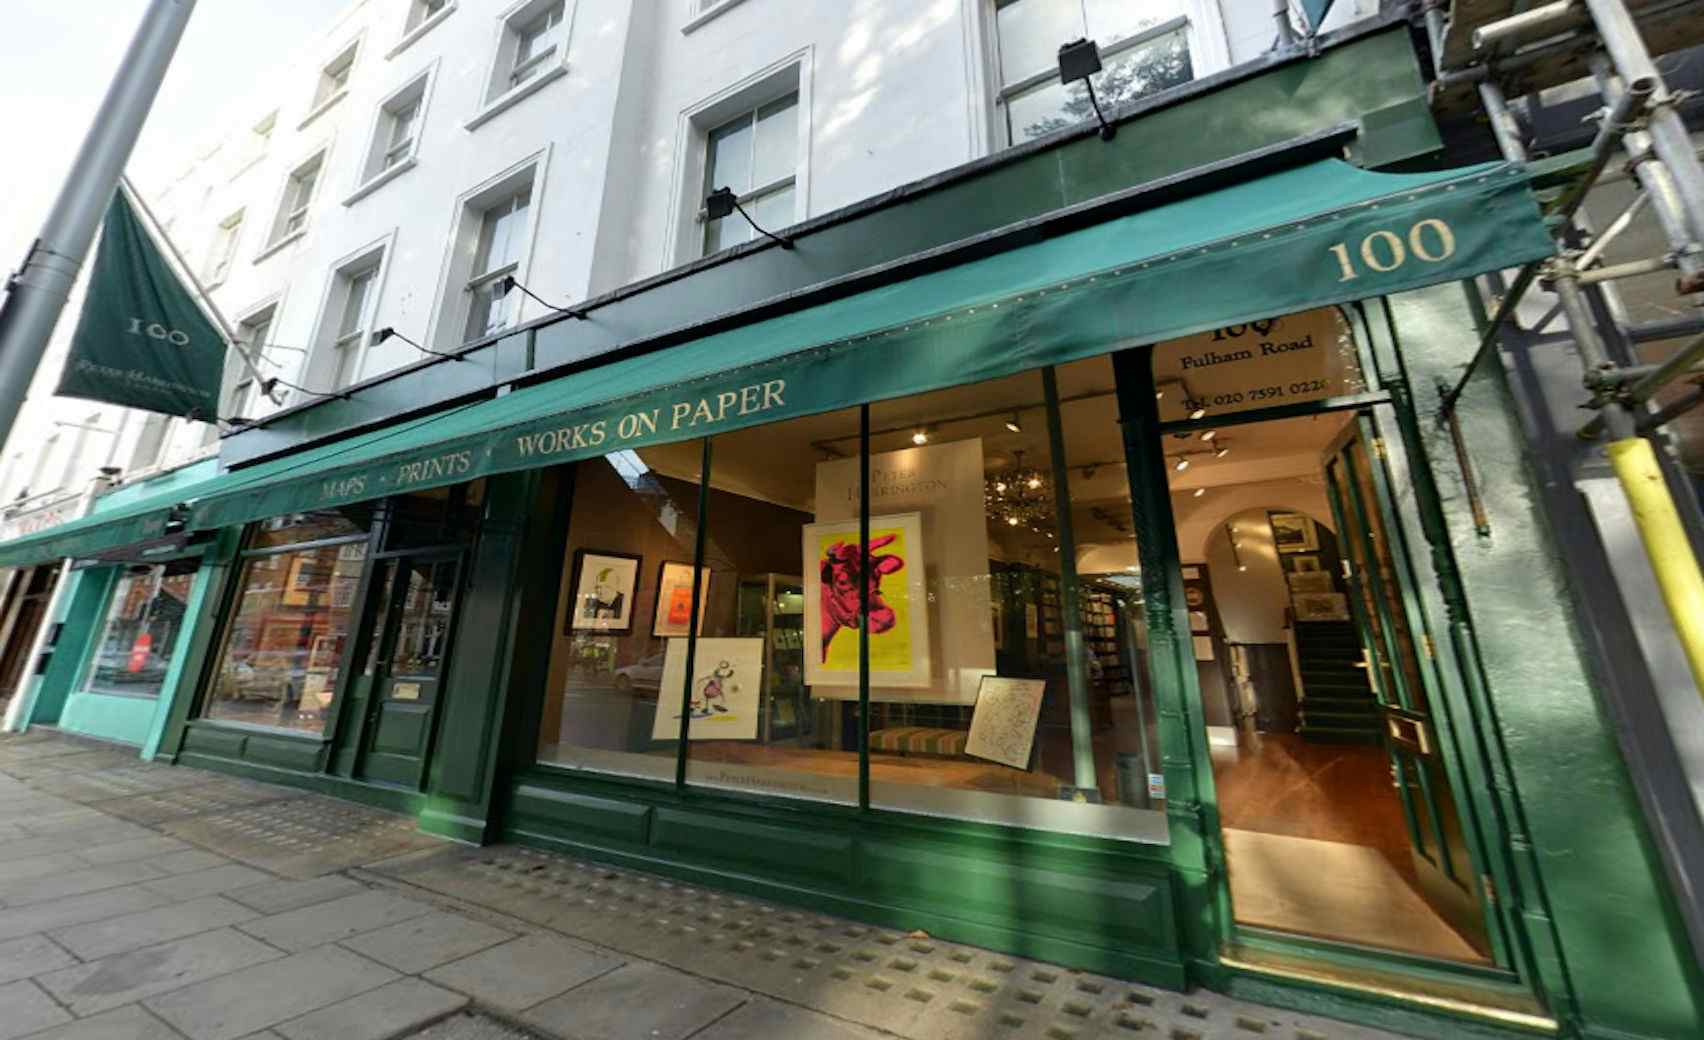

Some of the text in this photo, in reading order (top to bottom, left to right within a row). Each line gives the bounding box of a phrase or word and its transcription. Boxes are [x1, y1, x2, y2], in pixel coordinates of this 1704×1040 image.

[1328, 218, 1456, 282] 100
[126, 317, 189, 346] 100
[1181, 335, 1313, 370] Fulham Road
[1214, 391, 1245, 406] 020
[1248, 385, 1284, 401] 7591
[322, 378, 786, 498] MAPS PRINTS WORKS ON PAPER
